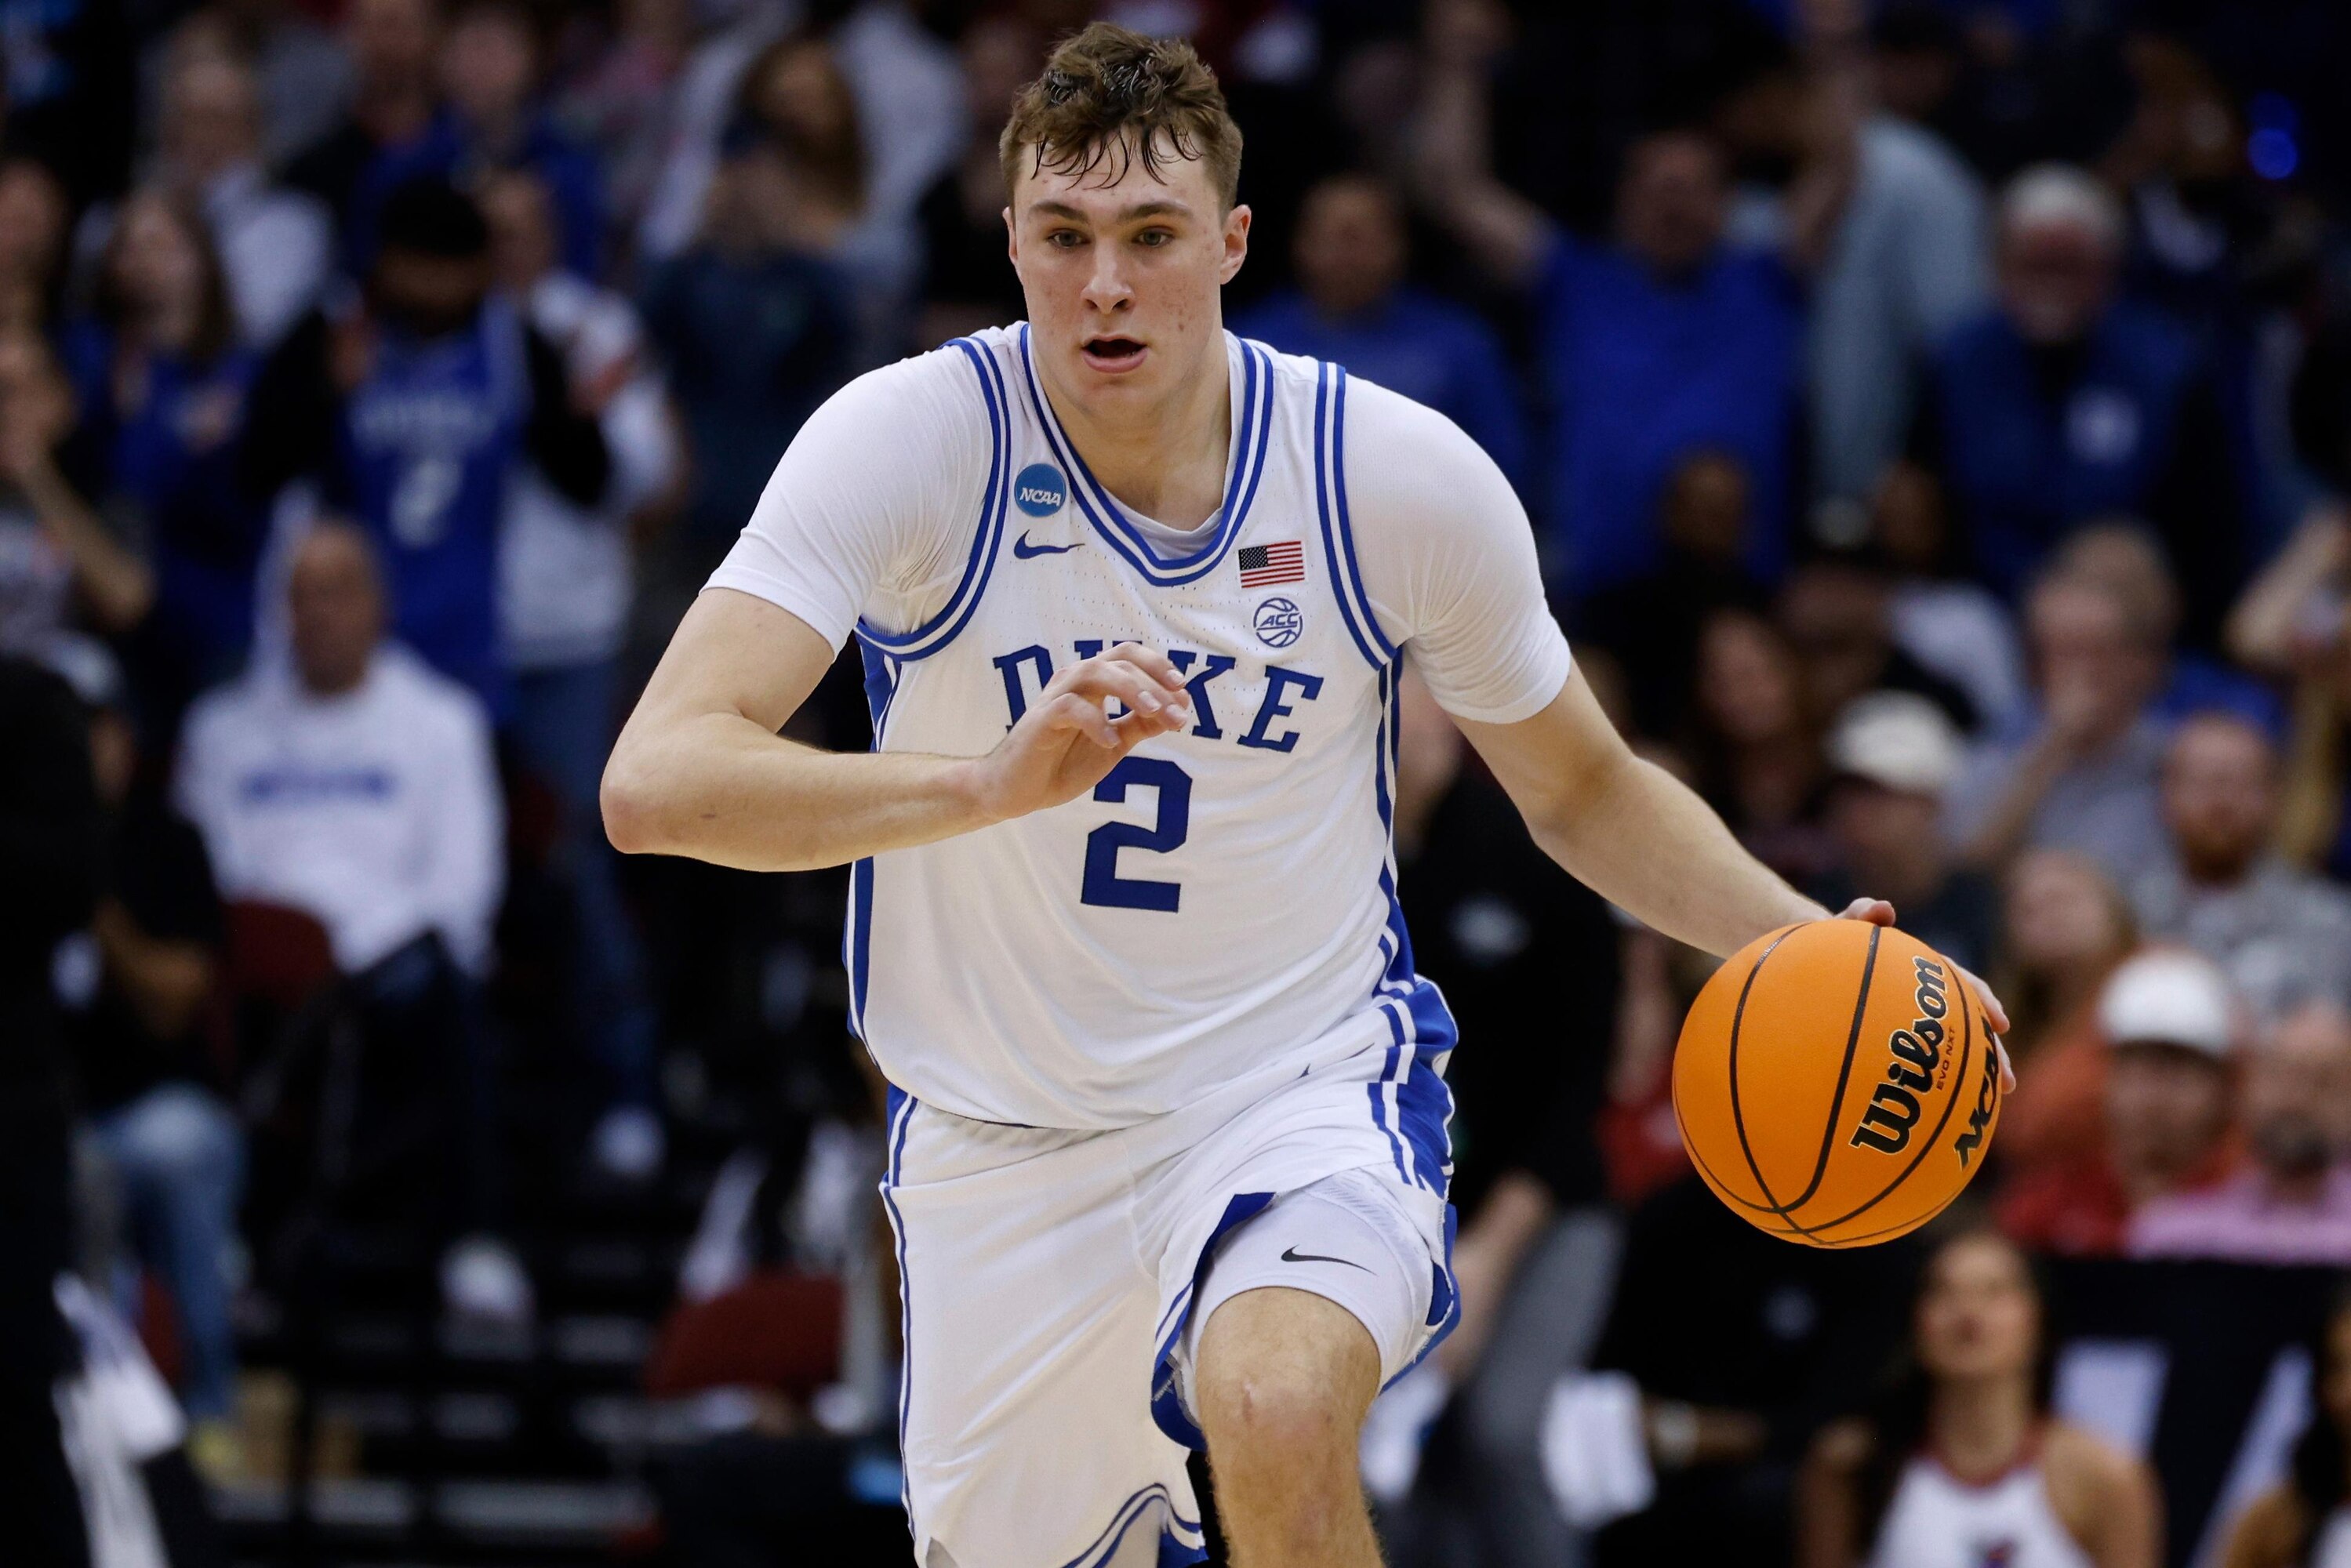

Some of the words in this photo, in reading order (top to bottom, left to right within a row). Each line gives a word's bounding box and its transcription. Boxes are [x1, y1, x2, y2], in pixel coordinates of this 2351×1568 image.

[1019, 487, 1061, 506] NCAA
[1260, 612, 1299, 627] ACC
[993, 640, 1324, 753] DKE
[1081, 756, 1193, 913] 2
[1848, 956, 1948, 1156] Wilson
[1936, 1059, 1950, 1091] EVO
[1945, 1025, 1956, 1057] NXT
